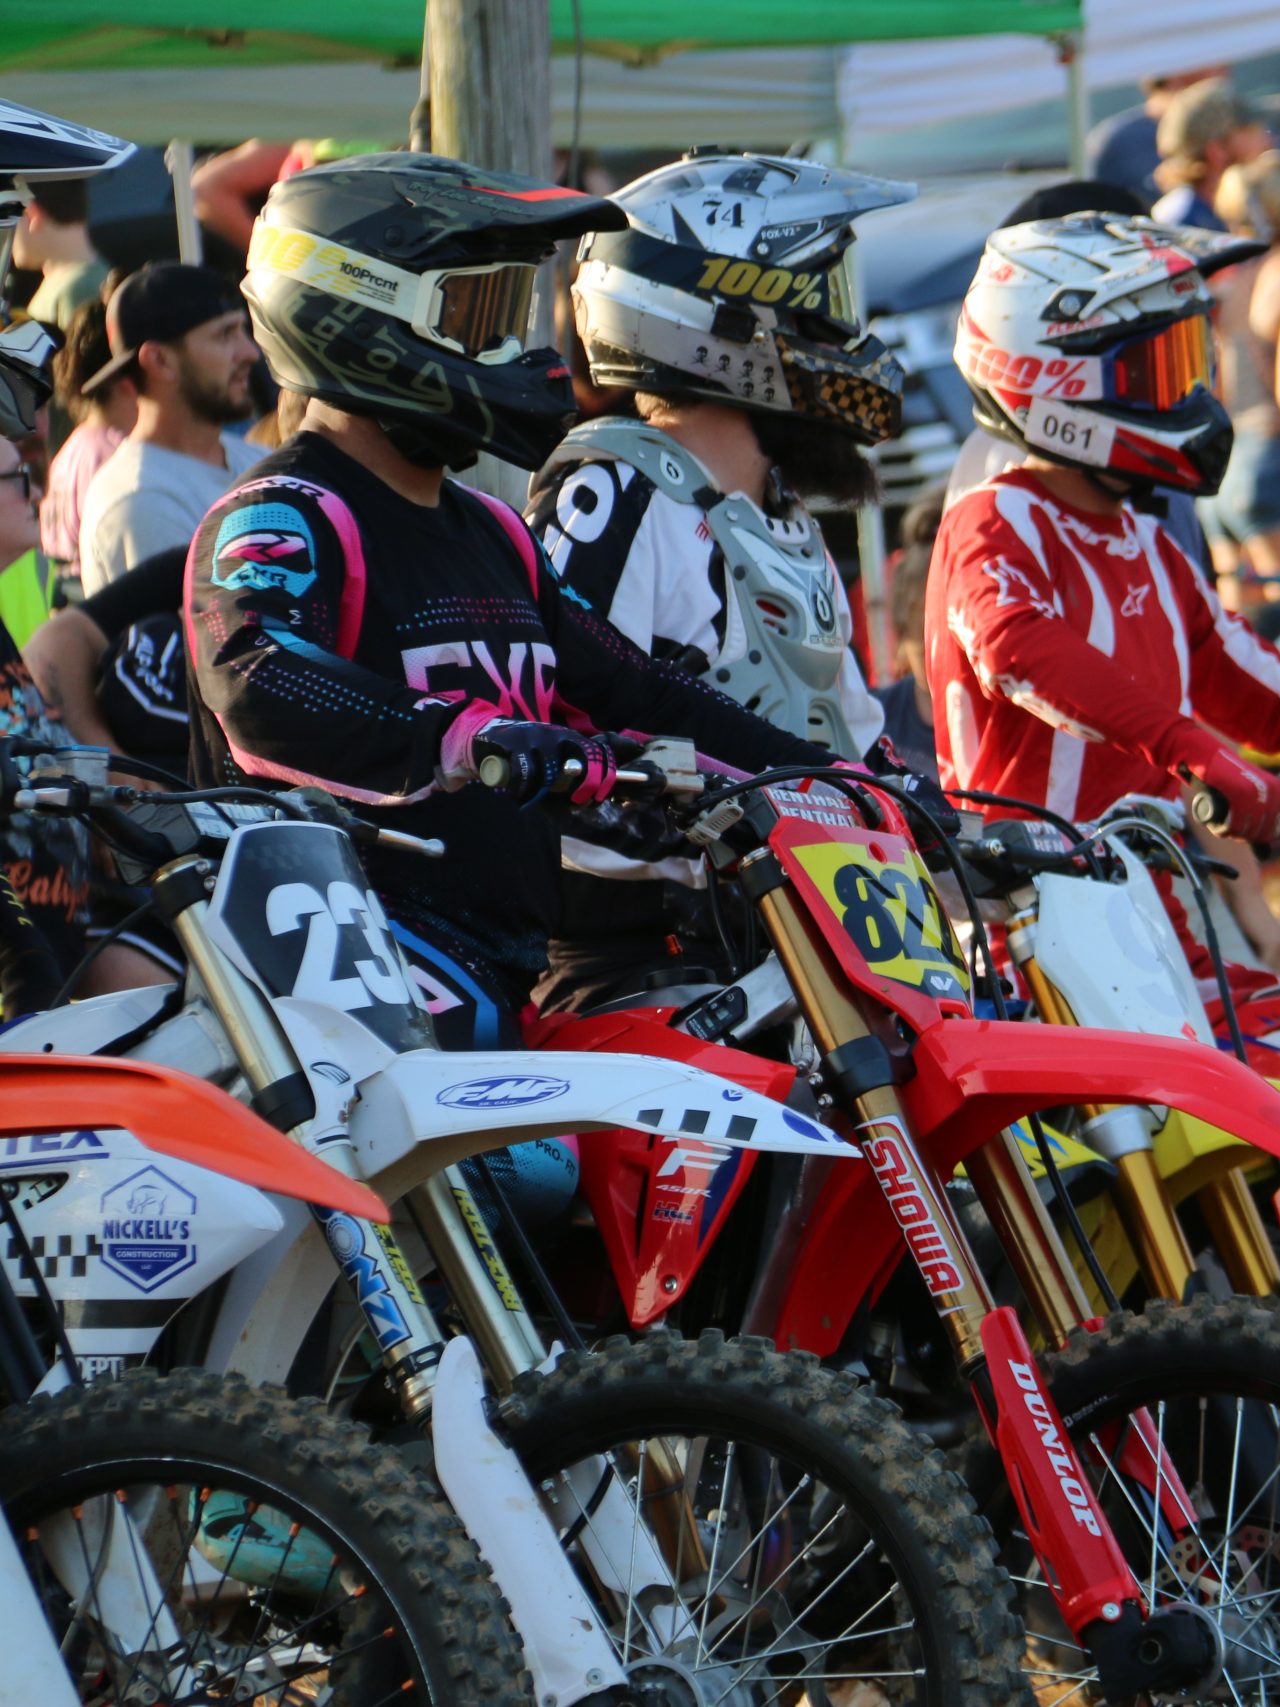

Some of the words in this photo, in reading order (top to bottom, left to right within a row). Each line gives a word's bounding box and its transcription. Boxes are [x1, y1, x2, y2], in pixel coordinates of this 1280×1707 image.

[702, 200, 745, 229] 74
[340, 262, 399, 291] 100Prcnt
[696, 256, 823, 310] 100%
[967, 341, 1087, 398] 100%
[1043, 415, 1093, 449] 061
[767, 788, 851, 810] RENTHAL
[437, 1079, 570, 1104] FMF
[655, 1183, 712, 1199] 450R
[102, 1219, 190, 1240] NICKELL'S
[861, 1136, 964, 1297] SHOWA
[115, 1250, 178, 1259] CONSTRUCTION
[1007, 1358, 1103, 1537] DUNLOP
